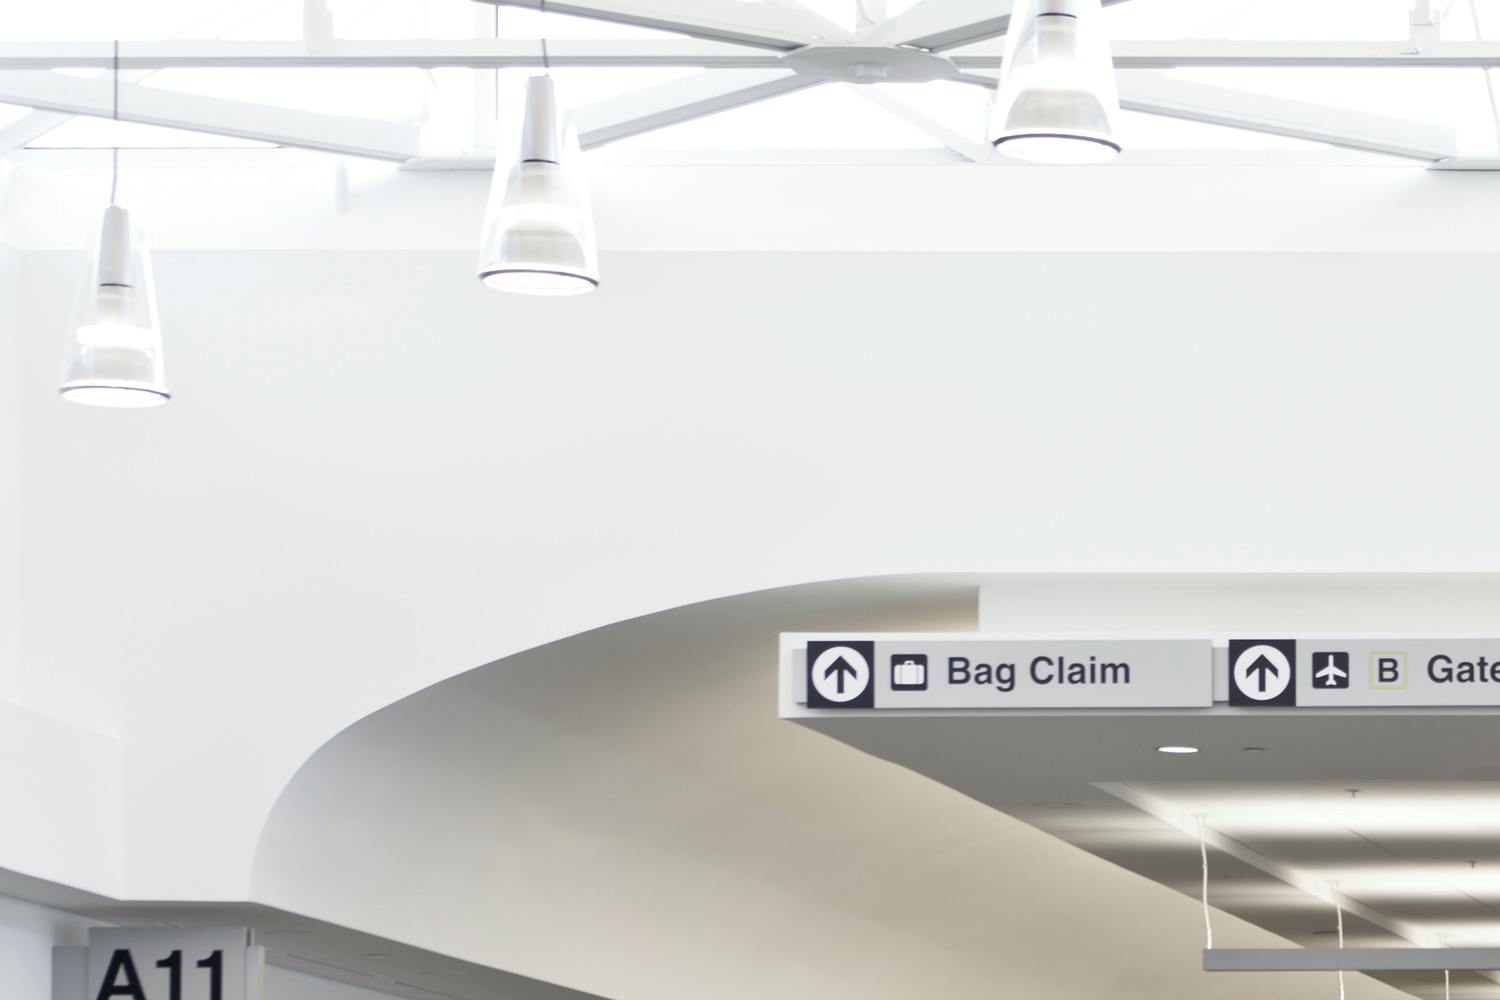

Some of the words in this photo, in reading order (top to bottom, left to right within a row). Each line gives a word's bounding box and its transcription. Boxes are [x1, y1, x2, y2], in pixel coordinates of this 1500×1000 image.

[948, 656, 1016, 693] Bag
[1030, 655, 1130, 685] Claim
[1378, 658, 1399, 683] B
